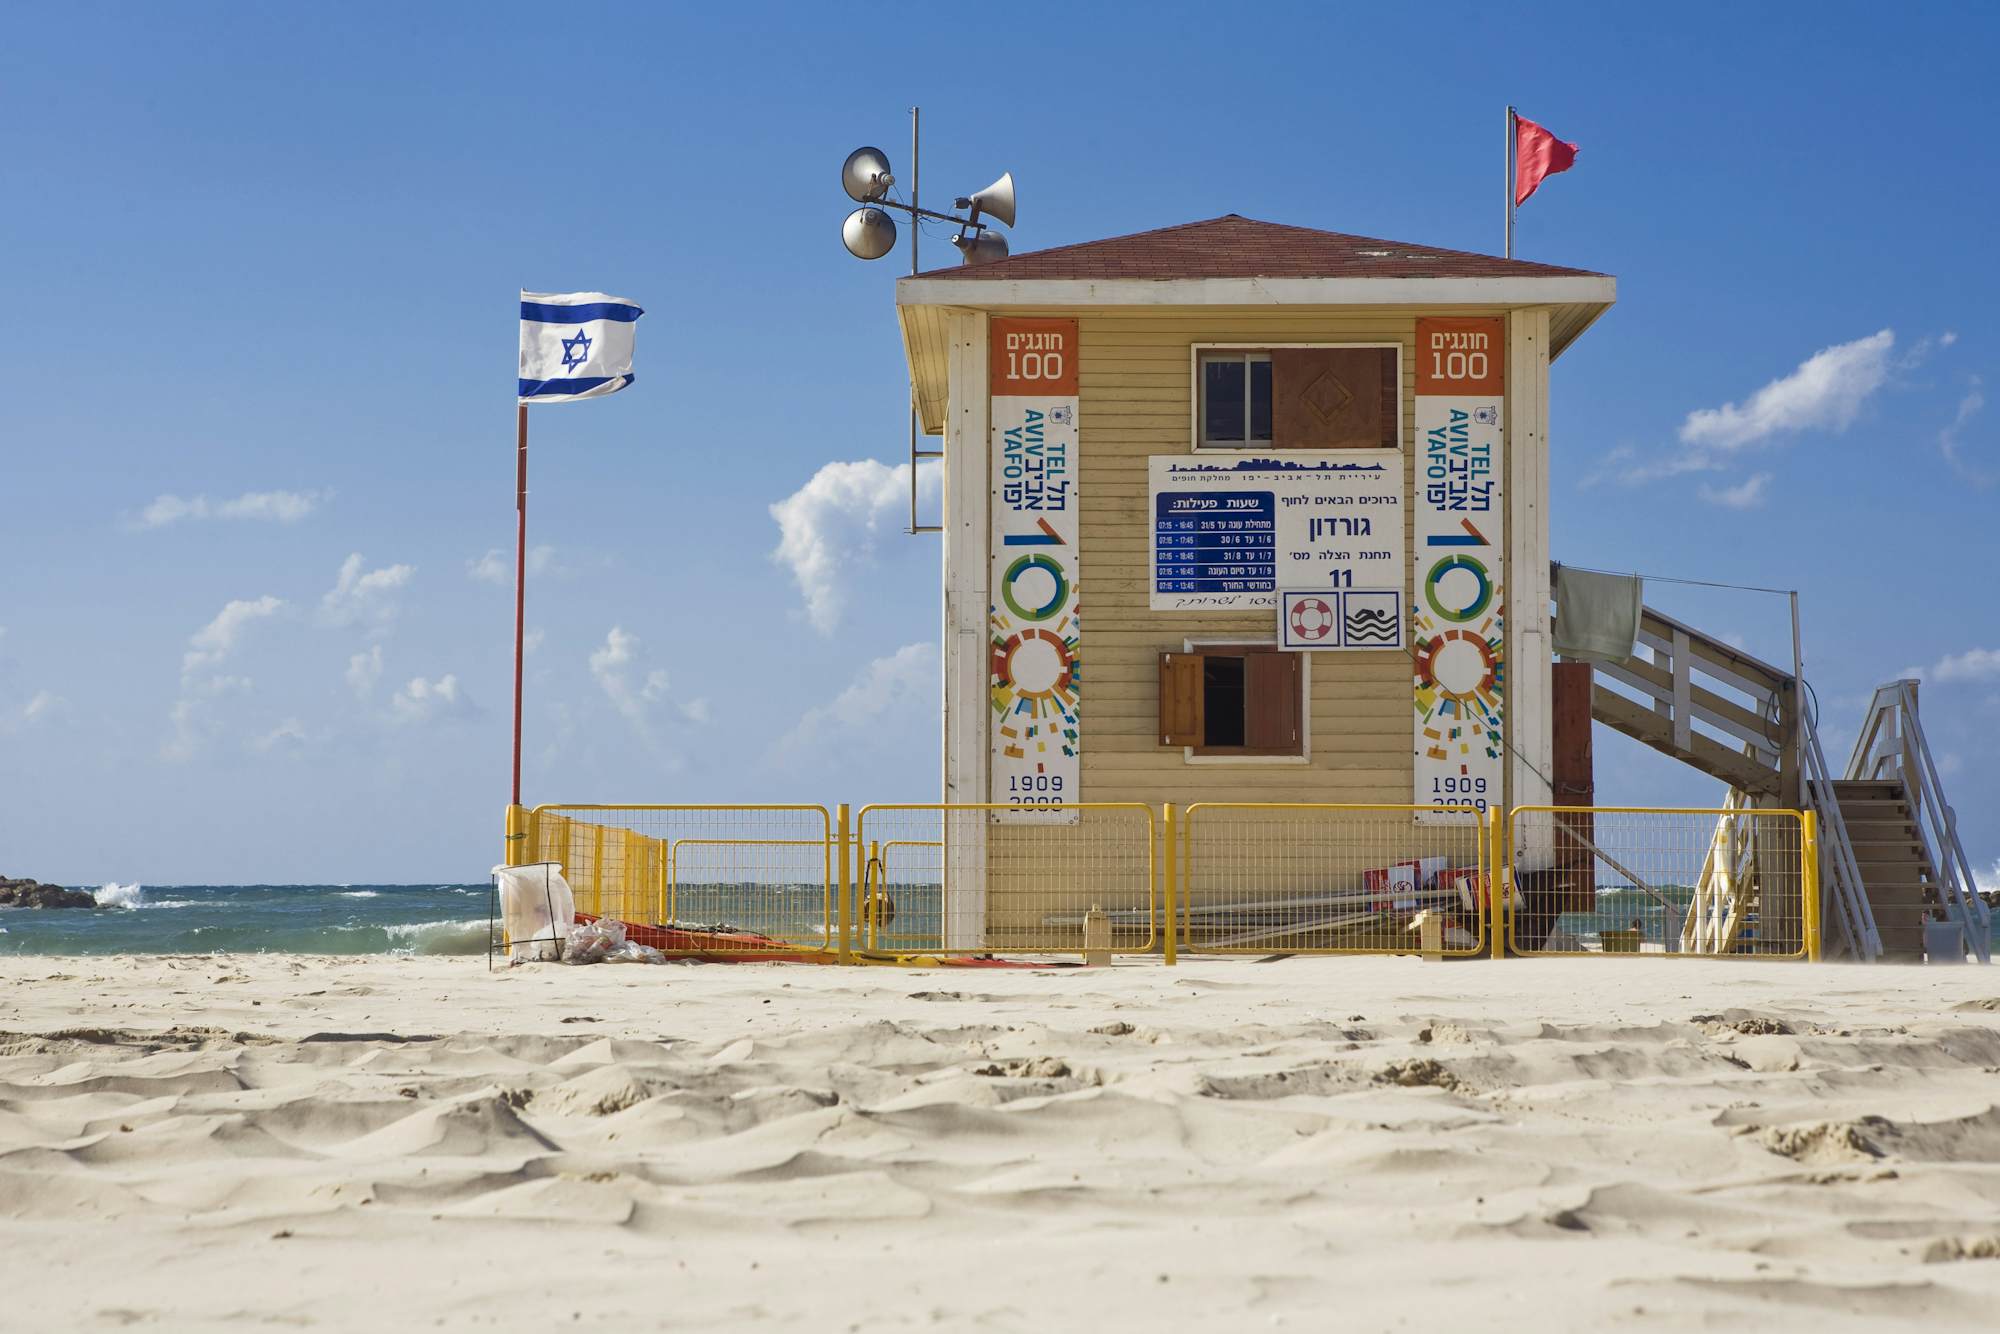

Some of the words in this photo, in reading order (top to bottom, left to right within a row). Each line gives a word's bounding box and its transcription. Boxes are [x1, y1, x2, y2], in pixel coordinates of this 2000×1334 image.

[1006, 333, 1062, 350] חוגגים
[1431, 332, 1488, 350] חוגגים
[1006, 353, 1062, 380] 100
[1431, 352, 1488, 380] 100
[1025, 409, 1044, 456] AVIV
[1450, 409, 1468, 457] AVIV
[1004, 427, 1022, 479] YAFO
[1428, 427, 1446, 479] YAFO
[1046, 443, 1065, 480] TEL
[1471, 443, 1490, 480] TEL
[1025, 459, 1043, 510] אביב
[1200, 474, 1230, 483] מחלקת
[1450, 459, 1468, 511] אביב
[1004, 482, 1022, 510] יפו
[1047, 481, 1070, 510] תל
[1281, 494, 1309, 507] לחוף
[1315, 496, 1353, 505] הבאים
[1359, 496, 1398, 505] ברוכים
[1428, 482, 1446, 511] יפו
[1471, 481, 1494, 511] תל
[1173, 498, 1218, 509] פעילות:
[1226, 499, 1259, 508] שעות
[1201, 521, 1215, 529] 31/5
[1217, 521, 1226, 529] עד
[1228, 521, 1242, 529] עונה
[1245, 519, 1271, 529] מתחילת
[1309, 518, 1371, 542] גורדון
[1221, 536, 1240, 544] 30/6
[1245, 536, 1254, 544] עד
[1258, 535, 1271, 544] 1/6
[1224, 552, 1241, 560] 31/8
[1245, 552, 1254, 560] עד
[1259, 552, 1272, 560] 1/7
[1319, 550, 1350, 560] הצלה
[1359, 551, 1391, 560] תחנת
[1208, 567, 1228, 575] העונה
[1248, 567, 1256, 575] עד
[1259, 567, 1272, 575] 1/9
[1329, 569, 1352, 588] 11
[1223, 582, 1243, 591] החורף
[1010, 776, 1062, 791] 1909
[1433, 778, 1486, 793] 1909
